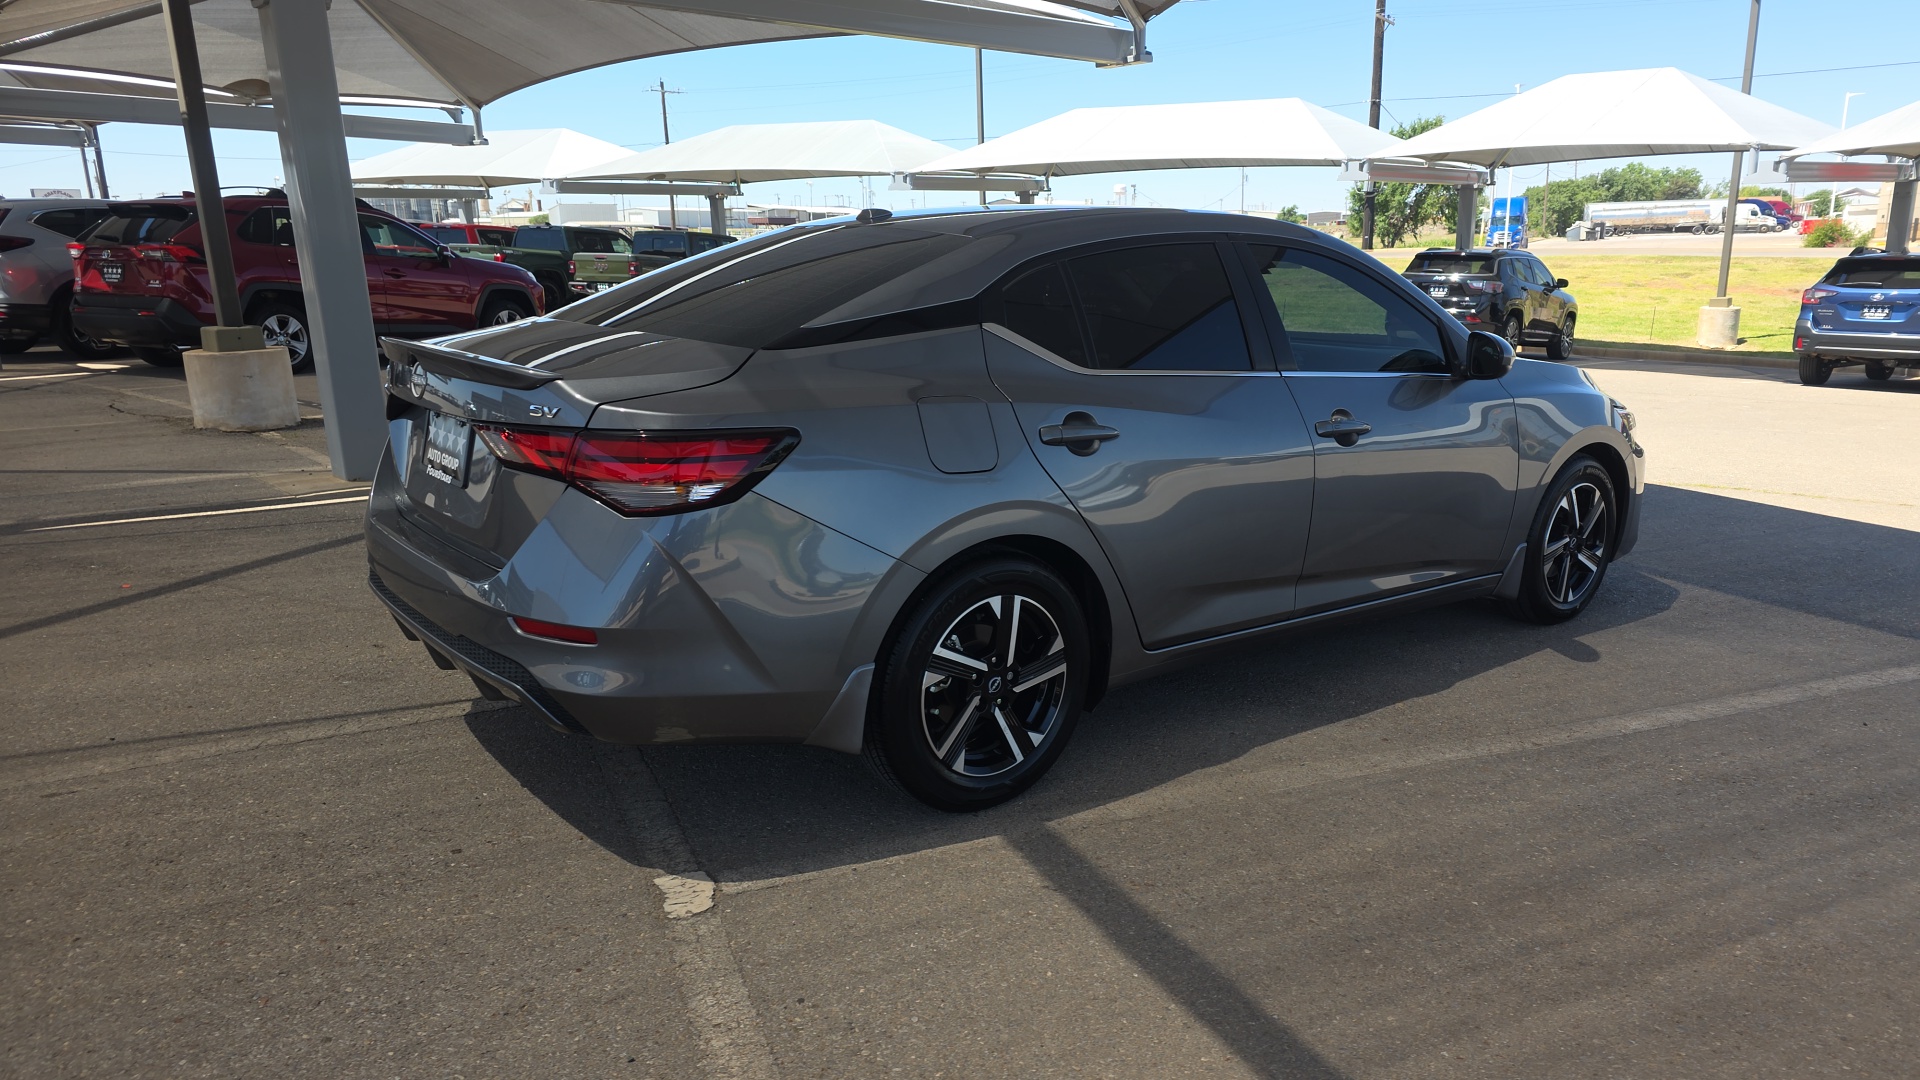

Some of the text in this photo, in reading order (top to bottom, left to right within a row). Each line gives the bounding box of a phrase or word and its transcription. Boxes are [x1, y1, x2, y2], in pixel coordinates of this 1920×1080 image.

[529, 404, 561, 419] SV
[427, 447, 459, 470] AUTO GROUP
